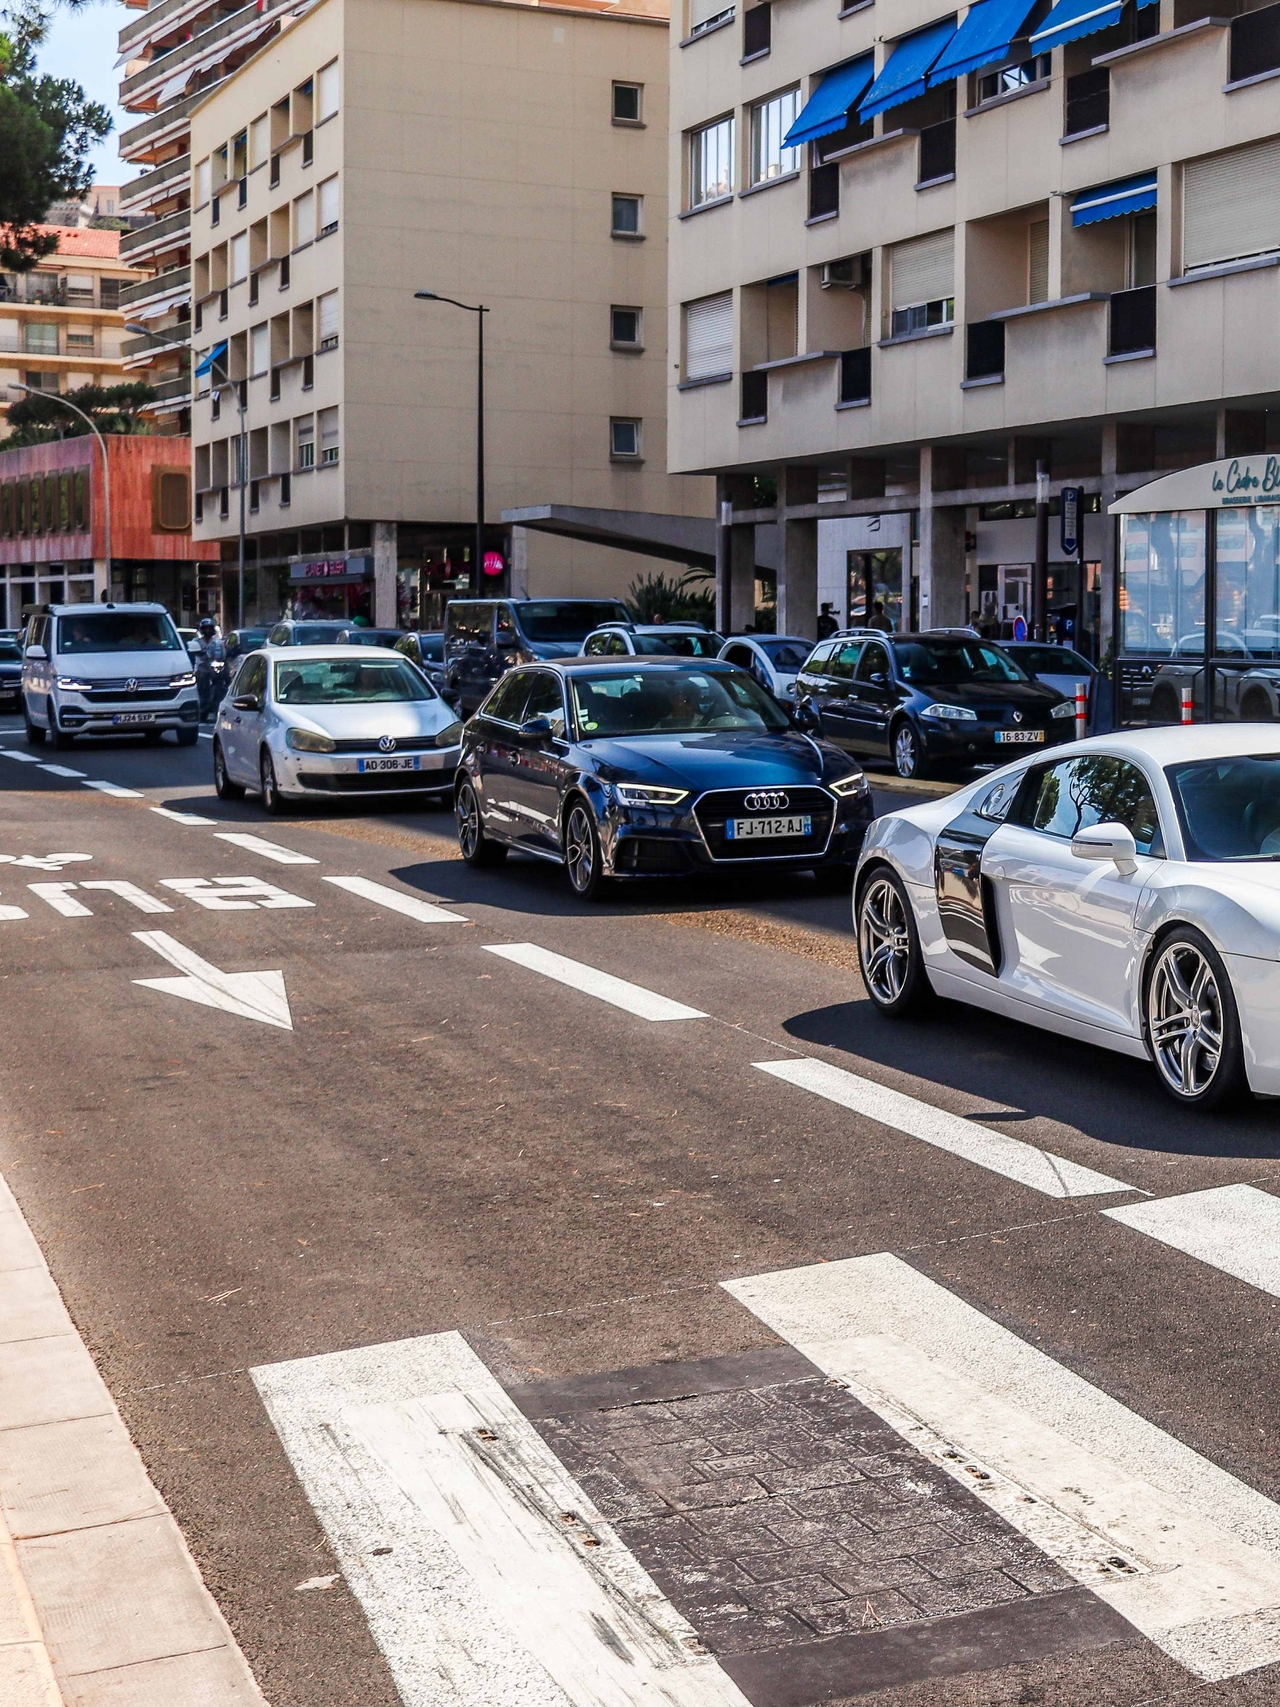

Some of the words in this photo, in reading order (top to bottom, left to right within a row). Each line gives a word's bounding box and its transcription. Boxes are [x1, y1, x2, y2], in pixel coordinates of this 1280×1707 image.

[1067, 491, 1074, 502] P
[1222, 496, 1252, 505] BRASSERIE
[1066, 619, 1073, 630] P
[737, 819, 803, 836] FJ-712-AJ
